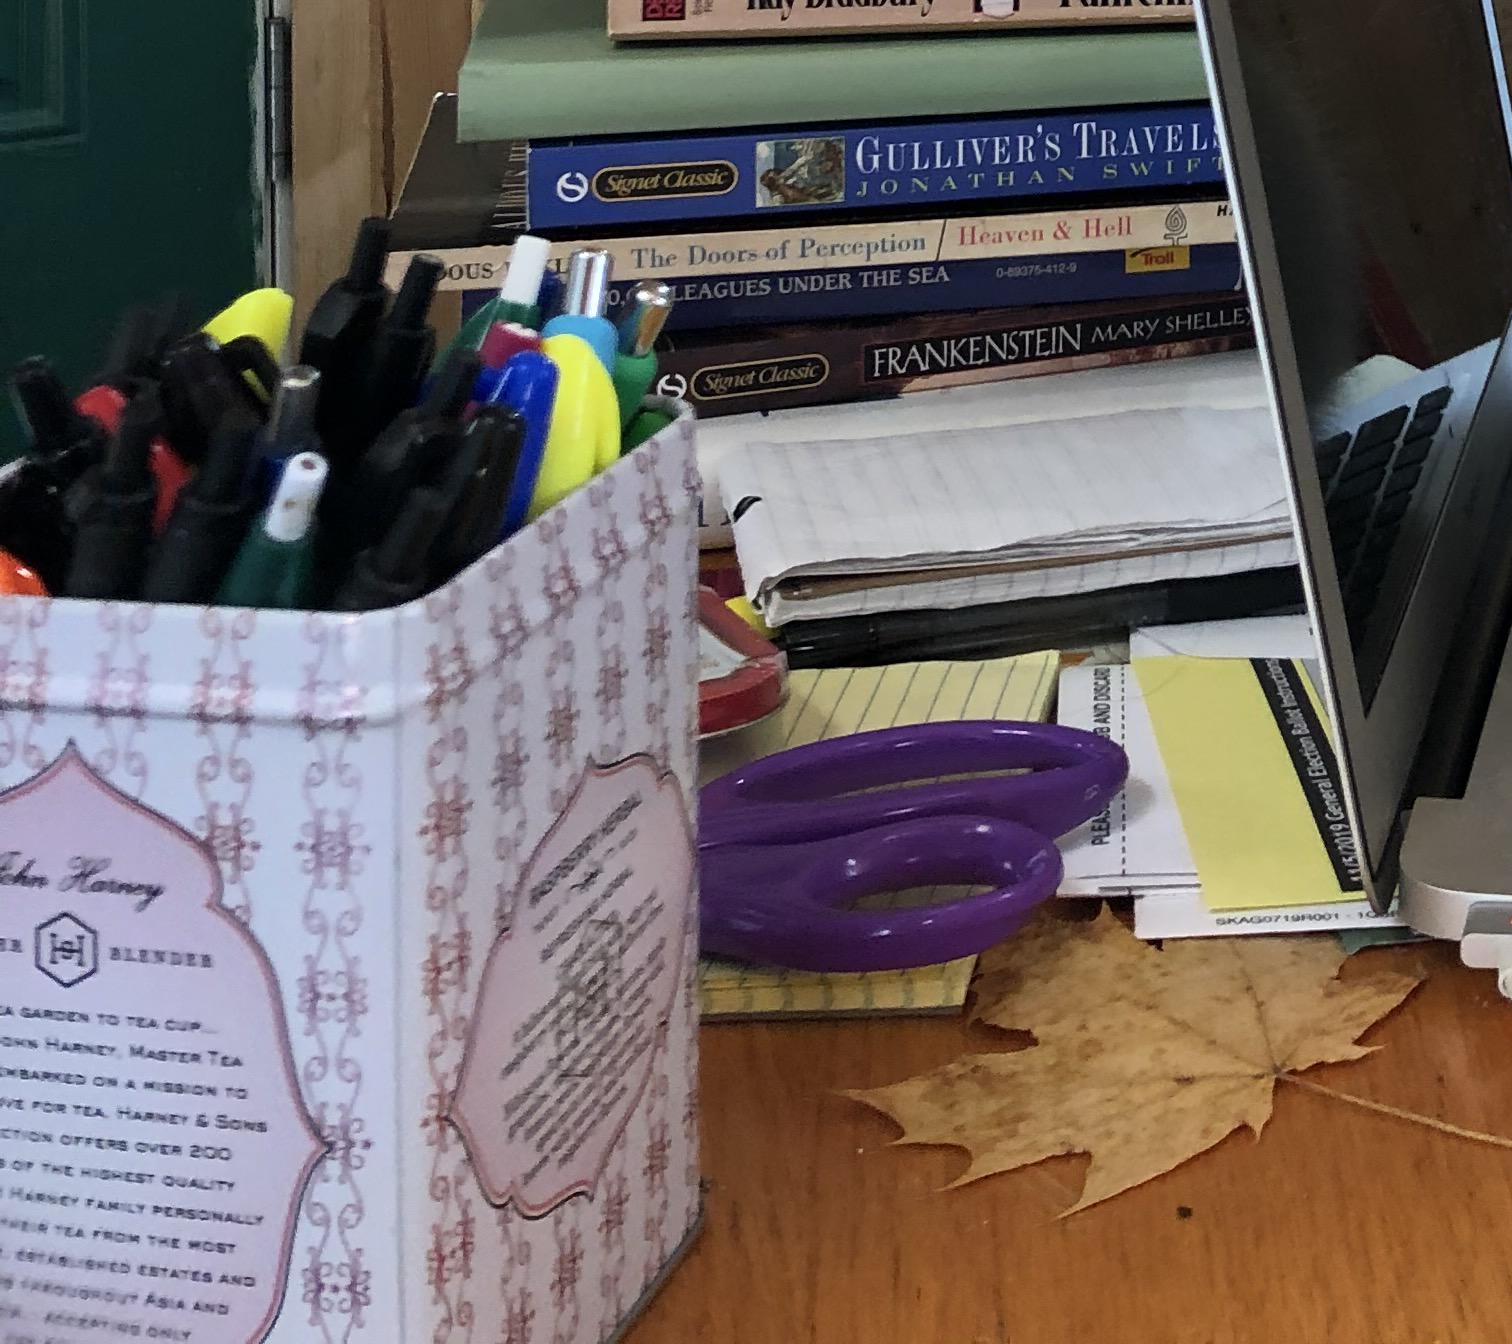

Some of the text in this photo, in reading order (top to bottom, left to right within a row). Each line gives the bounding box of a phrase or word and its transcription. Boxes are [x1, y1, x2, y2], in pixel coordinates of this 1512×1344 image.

[606, 167, 730, 196] Signet Classic
[856, 156, 1226, 198] JONATHAN SWIFT
[957, 215, 1133, 247] Heaven & Hell
[631, 232, 926, 270] The Doors of Perception
[1140, 249, 1175, 267] Troll
[671, 265, 951, 303] LEAGUES UNDER THE SEA
[873, 323, 1082, 378] FRANKENSTEIN
[1090, 317, 1160, 344] MARY
[703, 362, 821, 394] Signet Classic
[1093, 703, 1111, 725] AND
[1286, 707, 1310, 736] Ballot
[1299, 736, 1328, 777] Election
[1312, 779, 1345, 822] General
[109, 946, 214, 969] BLENDER
[19, 1007, 90, 1023] GARDEN
[97, 1012, 120, 1026] TO
[125, 1015, 158, 1029] TEA
[0, 1035, 39, 1050] OHN
[92, 1075, 118, 1088] ON
[124, 1078, 137, 1090] A
[143, 1081, 218, 1097] MISSION
[225, 1086, 248, 1100] TO
[31, 1100, 67, 1114] FOR
[59, 1134, 129, 1152] OFFERS
[134, 1141, 183, 1156] OVER
[189, 1144, 233, 1161] 200
[11, 1160, 35, 1172] OF
[41, 1162, 75, 1178] THE
[80, 1168, 156, 1184] HIGHEST
[161, 1174, 236, 1192] QUALITY
[84, 1198, 146, 1214] FAMILY
[151, 1204, 265, 1226] PERSONALLY
[55, 1224, 85, 1239] TEA
[92, 1229, 141, 1245] FROM
[147, 1233, 181, 1250] THE
[187, 1239, 236, 1254] MOST
[136, 1262, 214, 1285] ESTATES
[219, 1272, 256, 1288] AND
[192, 1300, 229, 1316] AND
[145, 1324, 193, 1343] ONLY
